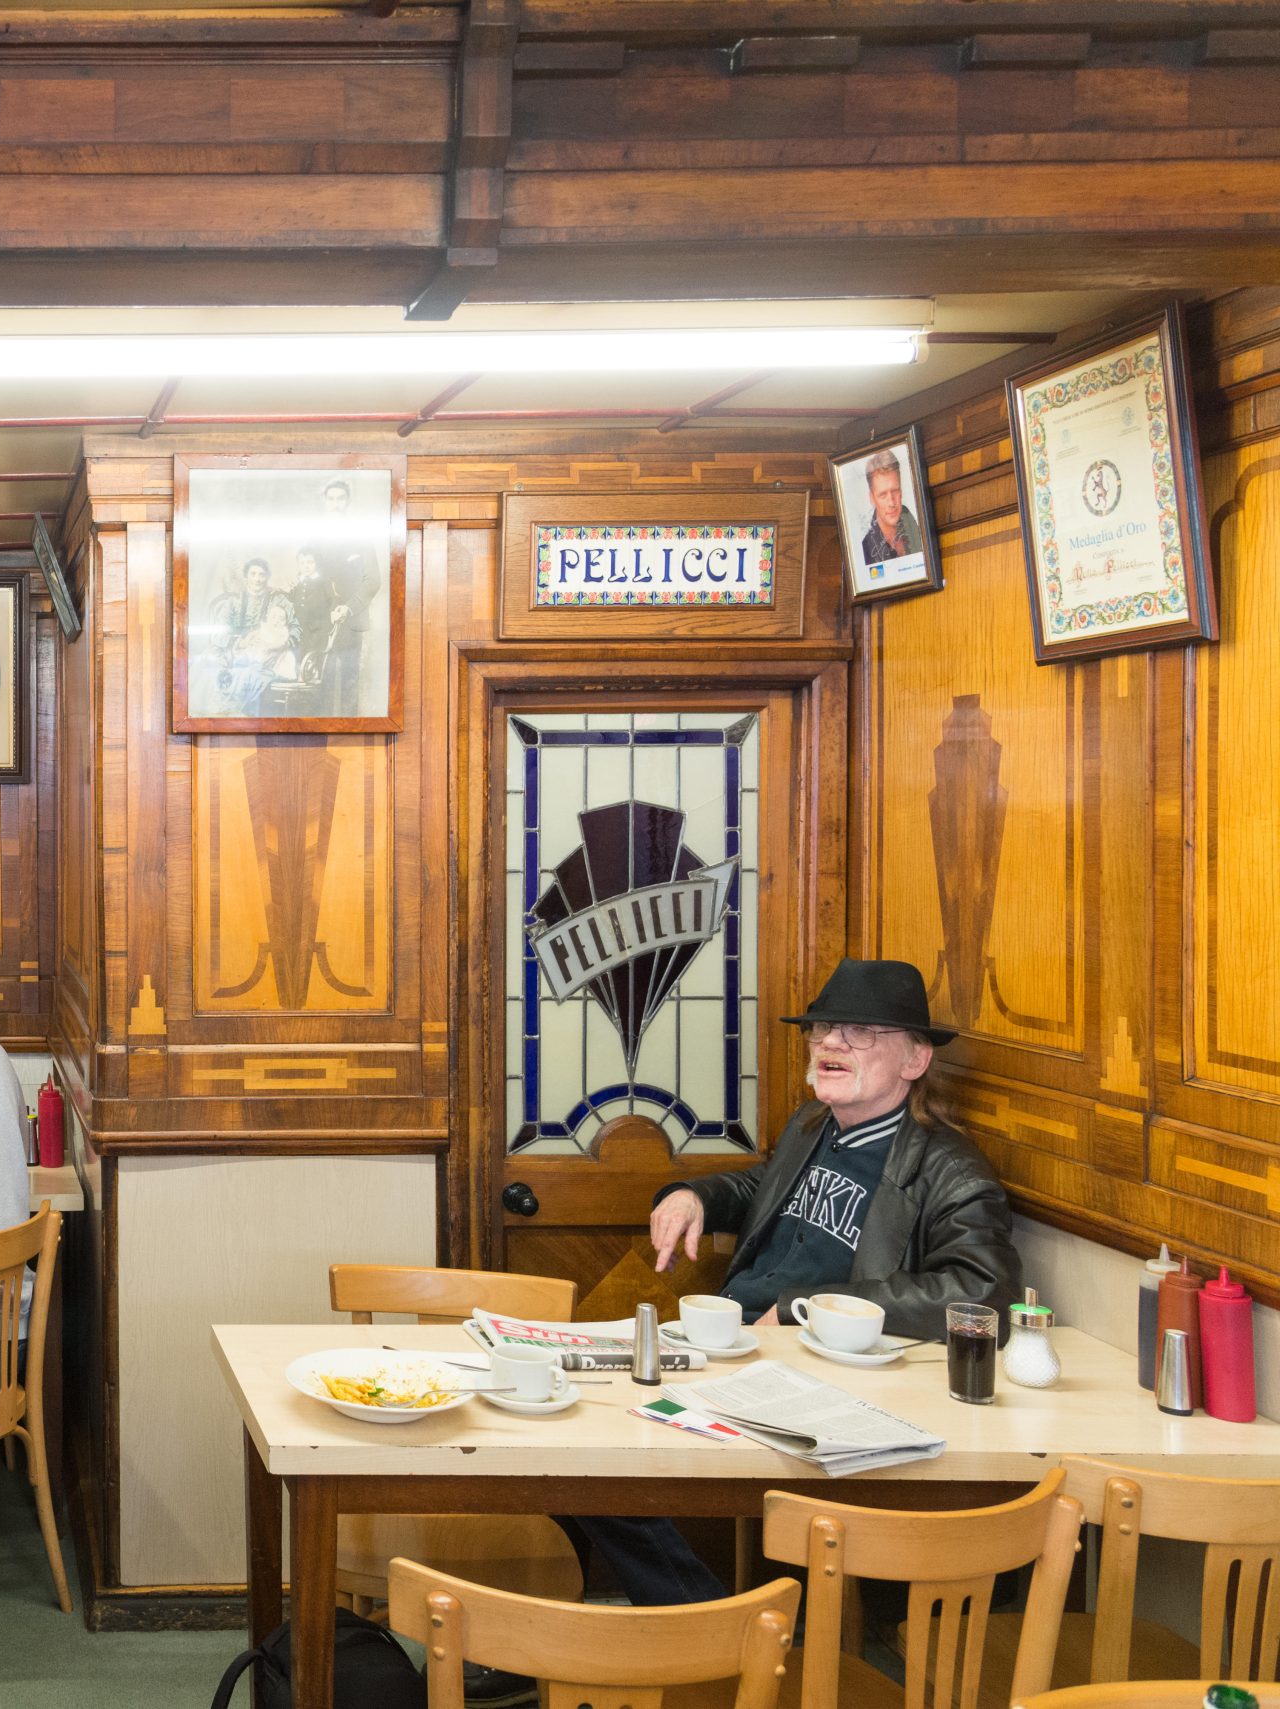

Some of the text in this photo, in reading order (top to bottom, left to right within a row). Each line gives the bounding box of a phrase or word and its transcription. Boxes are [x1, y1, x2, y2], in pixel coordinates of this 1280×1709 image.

[1069, 530, 1114, 550] Medaglia
[558, 548, 748, 583] PELLICCI
[548, 889, 703, 985] PELLICCI
[496, 1321, 590, 1344] Sun
